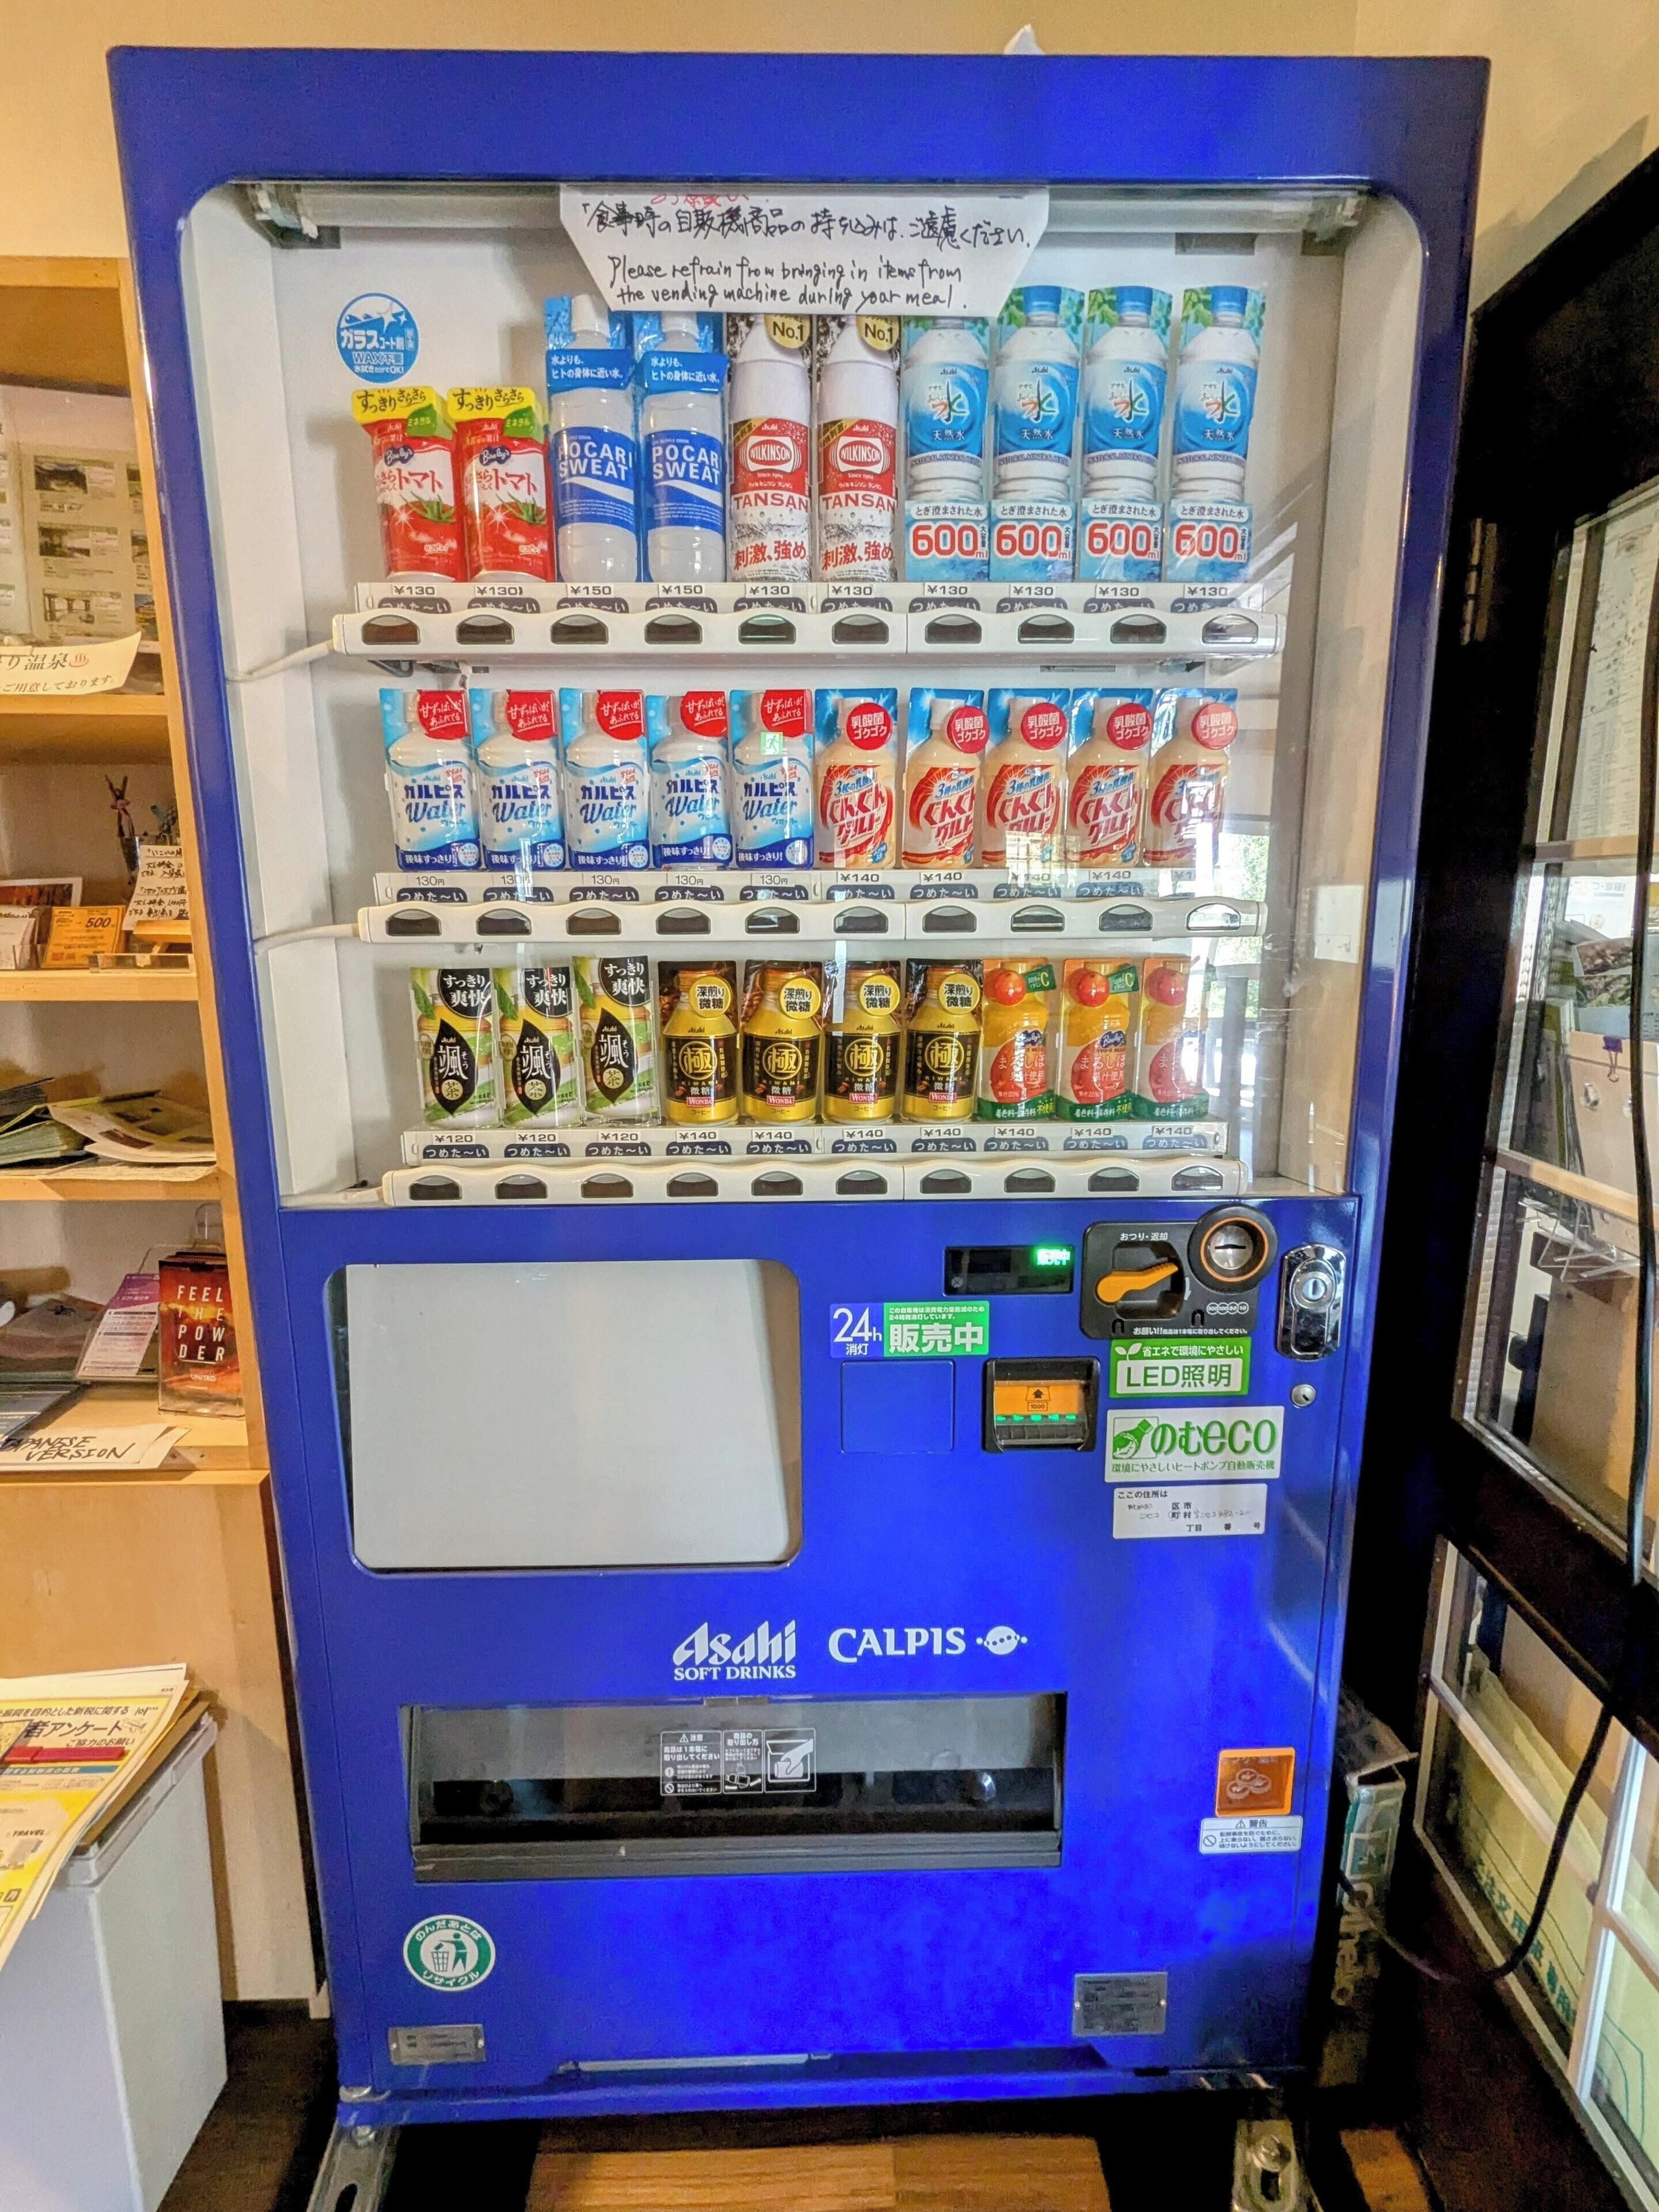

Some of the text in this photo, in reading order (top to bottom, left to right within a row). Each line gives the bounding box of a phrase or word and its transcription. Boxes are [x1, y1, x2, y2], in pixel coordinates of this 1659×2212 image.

[607, 255, 668, 288] Please
[672, 255, 732, 285] refrain
[736, 256, 775, 288] from
[850, 259, 868, 282] in
[877, 255, 916, 279] items
[918, 258, 962, 288] from
[616, 287, 646, 305] the
[653, 281, 719, 308] vending
[723, 283, 791, 302] machine
[772, 321, 805, 342] No.1
[864, 322, 894, 344] No.1
[933, 429, 965, 441] 天然水
[1021, 428, 1054, 441] 天然水
[1113, 427, 1145, 440] 天然水
[1203, 428, 1235, 442] 天然水
[558, 441, 633, 469] POCARI
[749, 444, 791, 461] WILKINSON
[841, 444, 881, 461] WILKINSON
[559, 459, 628, 482] SWEAT
[652, 462, 721, 486] SWEAT
[396, 468, 444, 493] トマト
[492, 468, 538, 492] トマト
[733, 493, 809, 513] TANSAN
[821, 493, 897, 513] TANSAN
[1092, 503, 1157, 518] とぎ澄まされた水
[915, 505, 983, 518] とぎ澄まされた水
[1000, 505, 1067, 518] とぎ澄まされた水
[1180, 504, 1245, 520] とぎ澄まされた水
[394, 585, 435, 596] ¥130
[476, 585, 518, 596] ¥130
[570, 585, 612, 596] ¥150
[661, 584, 703, 594] ¥150
[749, 585, 790, 595] ¥130
[832, 585, 873, 596] ¥130
[927, 585, 968, 595] ¥130
[1013, 586, 1054, 596] ¥130
[0, 652, 69, 671] り温泉
[851, 712, 885, 728] 乳酸菌
[854, 725, 887, 741] ゴクゴク
[404, 784, 464, 800] カルピス
[405, 800, 466, 823] Water
[493, 800, 552, 823] Water
[580, 802, 637, 824] Water
[665, 795, 719, 817] Water
[743, 797, 797, 821] Water
[738, 852, 783, 863] 後味すっきり!
[85, 917, 111, 928] 500
[604, 961, 645, 978] すっきり
[443, 974, 486, 988] すっきり
[526, 973, 566, 988] すっきり
[612, 978, 645, 996] 爽快
[696, 986, 725, 997] 深煎り
[783, 988, 812, 1001] 深煎り
[863, 984, 892, 997] 深煎り
[944, 984, 973, 996] 深煎り
[449, 990, 486, 1008] 爽快
[533, 990, 567, 1007] 爽快
[699, 998, 724, 1010] 微糖
[786, 1000, 811, 1013] 微糖
[865, 997, 891, 1009] 微糖
[946, 996, 972, 1007] 微糖
[598, 1032, 630, 1069] 颯
[850, 1044, 880, 1071] 極
[930, 1041, 959, 1069] 極
[437, 1044, 469, 1081] 颯
[520, 1044, 552, 1080] 颯
[683, 1047, 714, 1074] 極
[767, 1047, 796, 1074] 極
[605, 1069, 622, 1086] 茶
[444, 1080, 461, 1098] 茶
[528, 1080, 544, 1098] 茶
[434, 1134, 473, 1143] ¥120
[518, 1134, 556, 1142] ¥120
[601, 1132, 639, 1142] ¥120
[679, 1131, 717, 1141] ¥140
[755, 1131, 793, 1140] ¥140
[845, 1129, 884, 1139] ¥140
[923, 1127, 961, 1138] ¥140
[997, 1127, 1035, 1137] ¥140
[1074, 1127, 1112, 1137] ¥140
[1155, 1126, 1192, 1136] ¥140
[1120, 1232, 1168, 1241] おつり・返却
[177, 1285, 224, 1302] FEEL
[179, 1305, 225, 1321] THE
[177, 1324, 225, 1342] POW
[889, 1322, 984, 1353] 販売中
[179, 1344, 225, 1362] DER
[846, 1343, 868, 1355] 消灯
[1142, 1345, 1244, 1357] 省エネで環境にやさしい
[1126, 1363, 1232, 1388] LED照明
[2, 1436, 97, 1453] APANESE
[26, 1443, 136, 1462] VERSION
[1111, 1459, 1275, 1474] 環境にやさしいヒートポンプ自動販売機
[1118, 1490, 1168, 1499] ここの住所は
[1186, 1524, 1202, 1532] 丁目
[672, 1619, 797, 1666] Asahi
[828, 1627, 967, 1664] CALPIS
[674, 1665, 797, 1681] SOFT DRINKS
[12, 1829, 45, 1837] TRAVEL
[415, 1919, 482, 1942] のんだあとは
[422, 1969, 480, 1987] リサイクル
